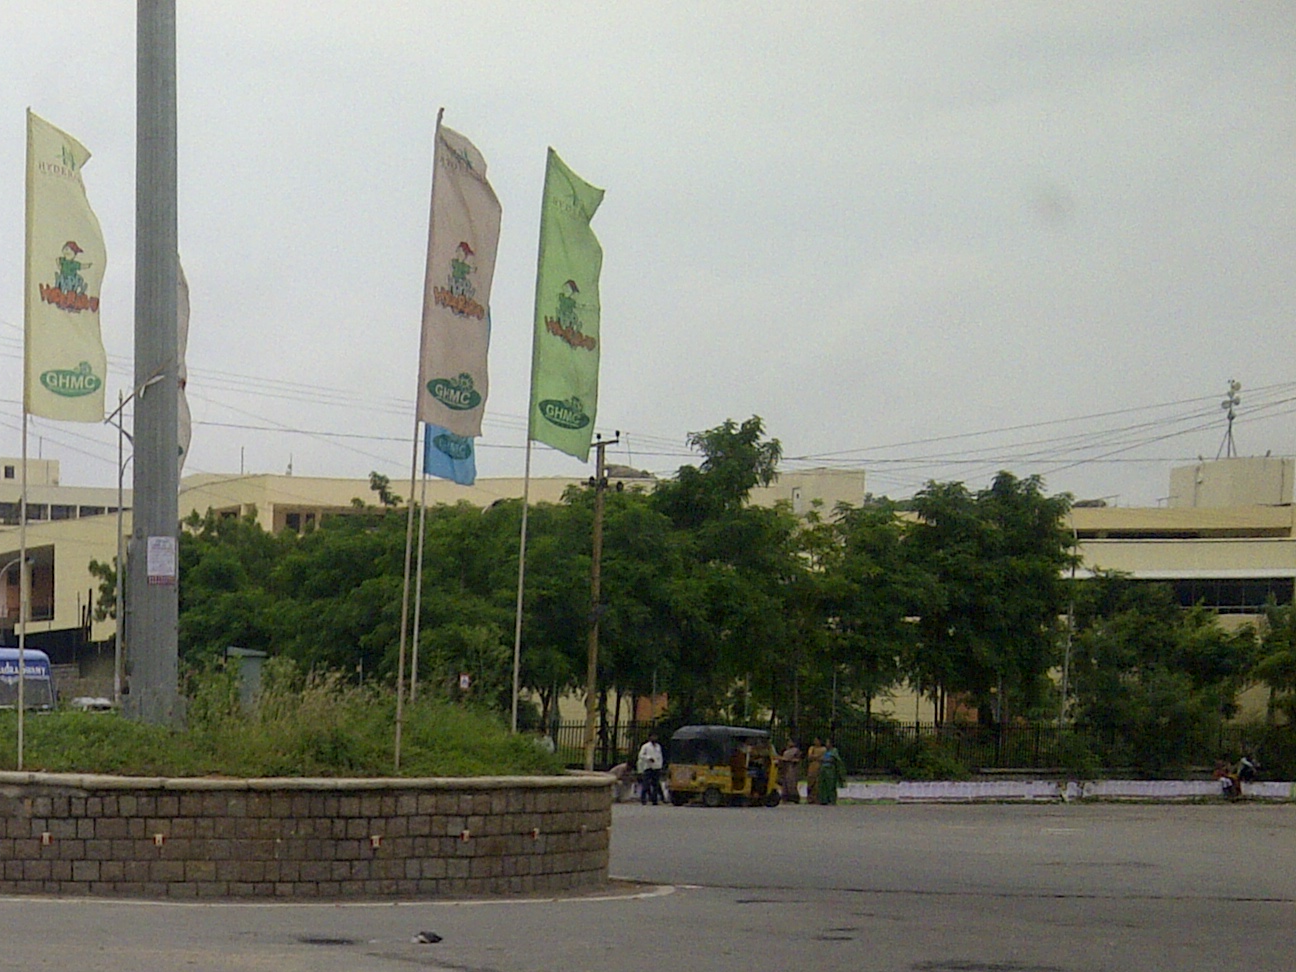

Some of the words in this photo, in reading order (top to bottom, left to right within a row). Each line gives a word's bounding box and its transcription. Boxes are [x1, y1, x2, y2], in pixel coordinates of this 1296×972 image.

[46, 372, 96, 389] GHMC
[435, 384, 471, 404] GHMC
[546, 404, 581, 424] GHMC
